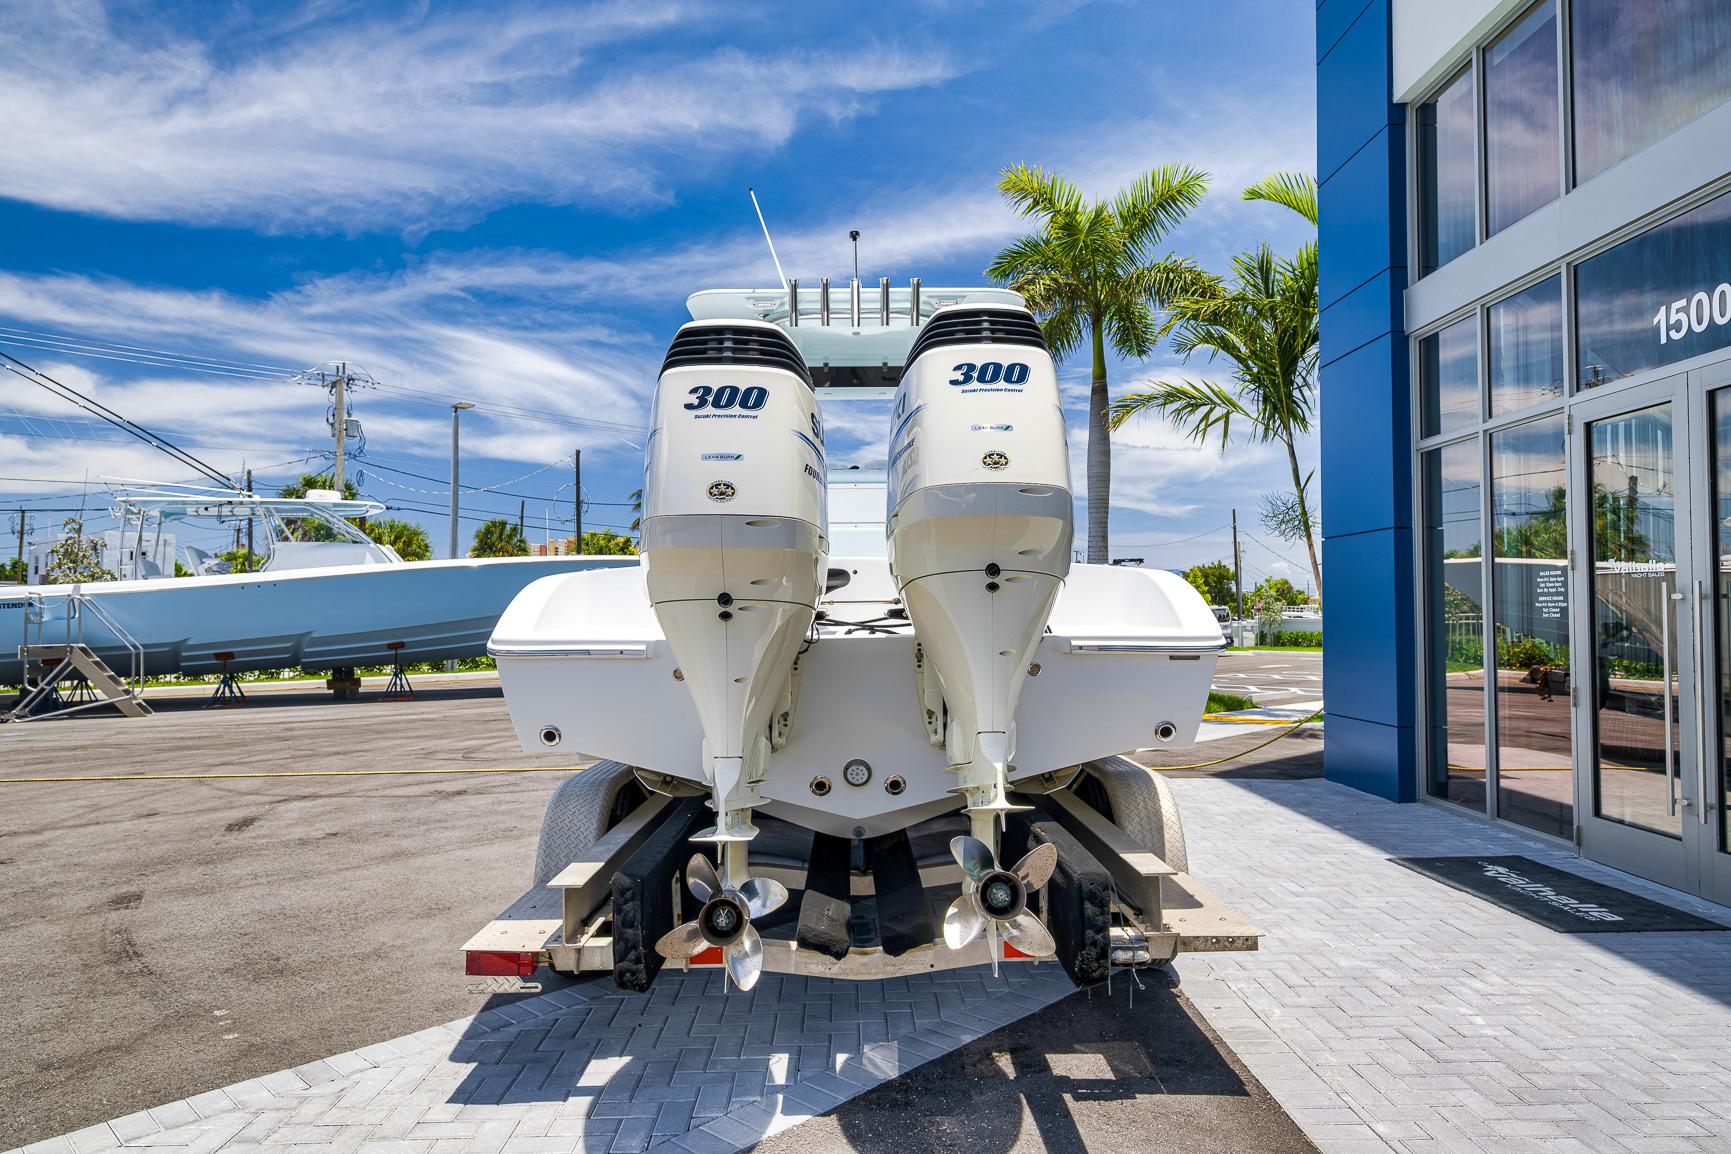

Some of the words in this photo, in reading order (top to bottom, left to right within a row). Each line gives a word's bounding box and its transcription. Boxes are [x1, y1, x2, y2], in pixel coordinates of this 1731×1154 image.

[1652, 282, 1731, 345] 1500
[948, 361, 1031, 386] 300
[683, 385, 770, 411] 300
